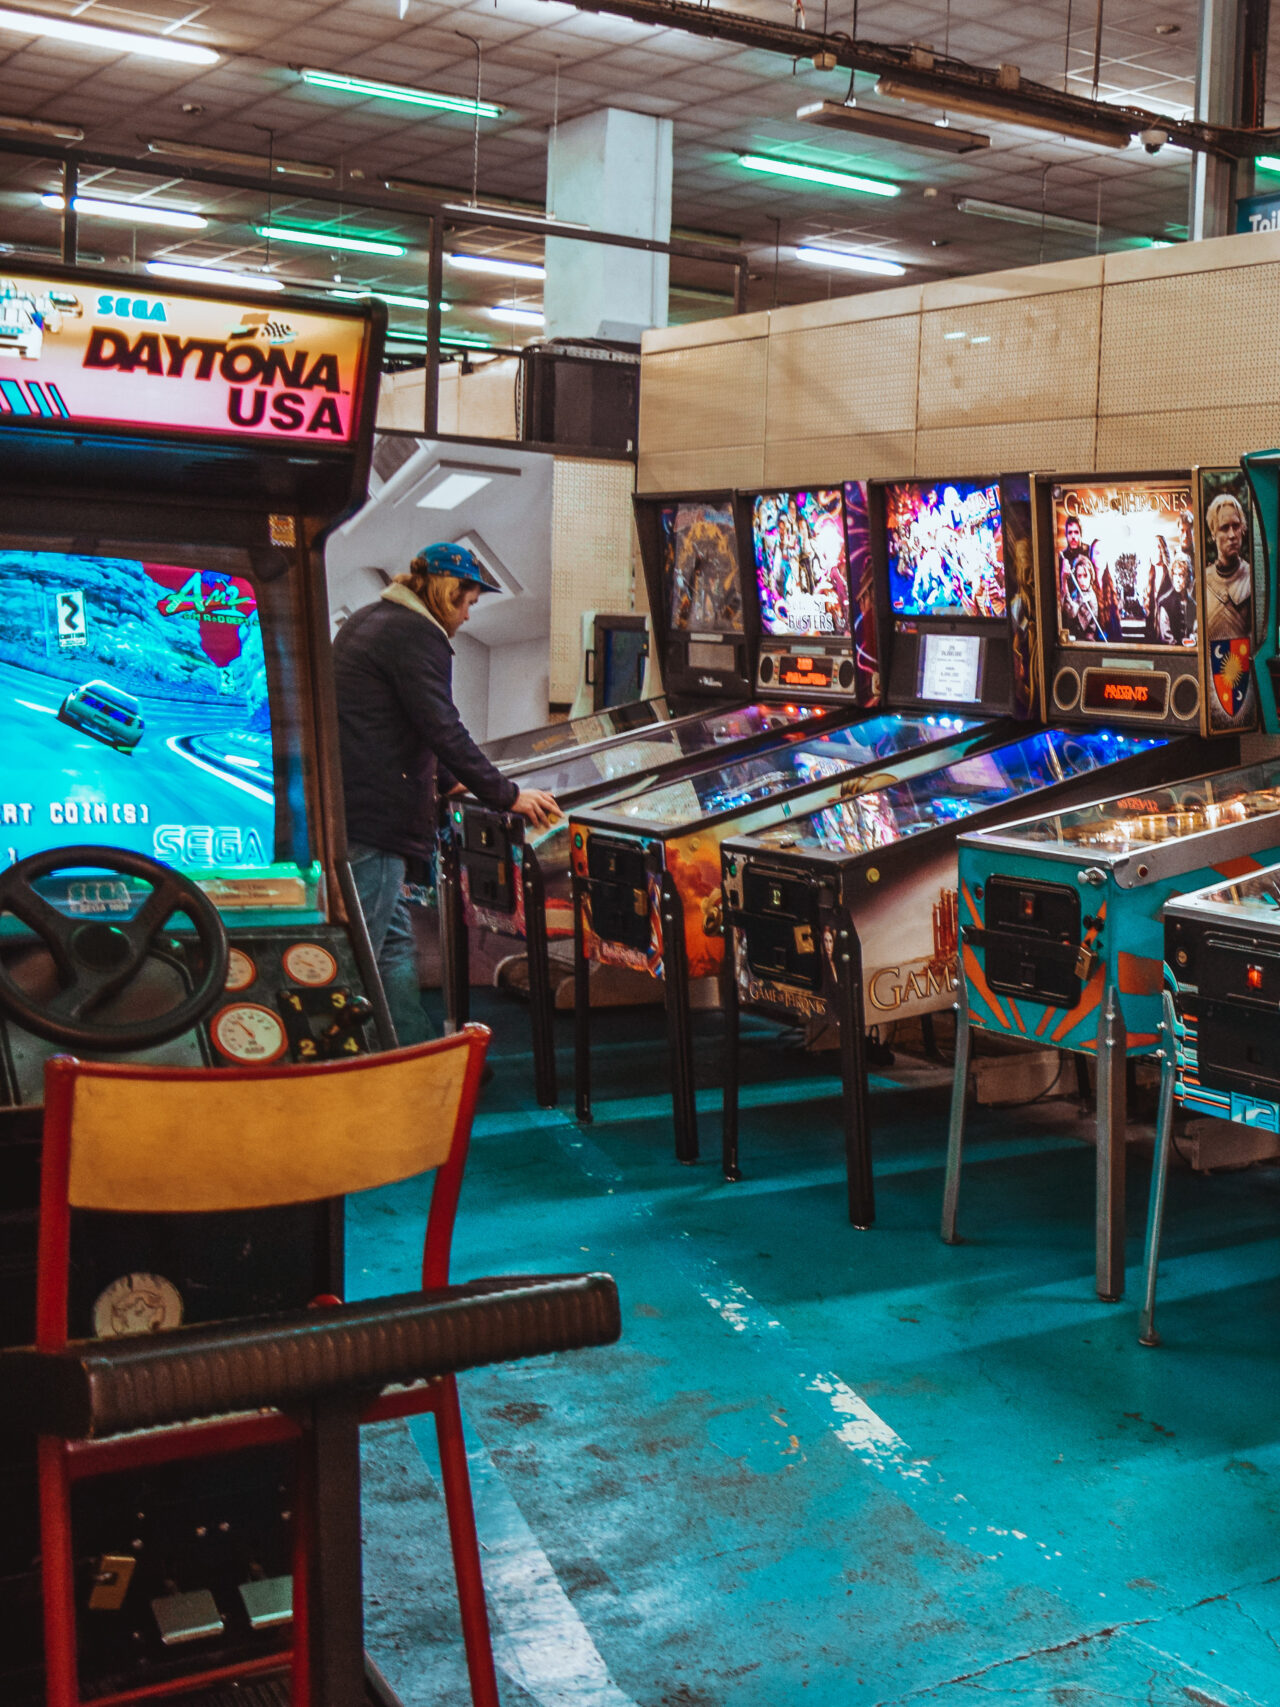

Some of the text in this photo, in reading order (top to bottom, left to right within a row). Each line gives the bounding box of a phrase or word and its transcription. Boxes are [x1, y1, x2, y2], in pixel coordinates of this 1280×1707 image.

[98, 296, 167, 322] SEGA
[82, 327, 343, 394] DAYTONA
[228, 387, 344, 436] USA
[1117, 488, 1189, 516] THRONES
[50, 803, 150, 825] COIN(S)
[153, 824, 269, 869] SEGA
[331, 993, 346, 1008] 3
[300, 1039, 316, 1056] 2
[343, 1037, 359, 1052] 4
